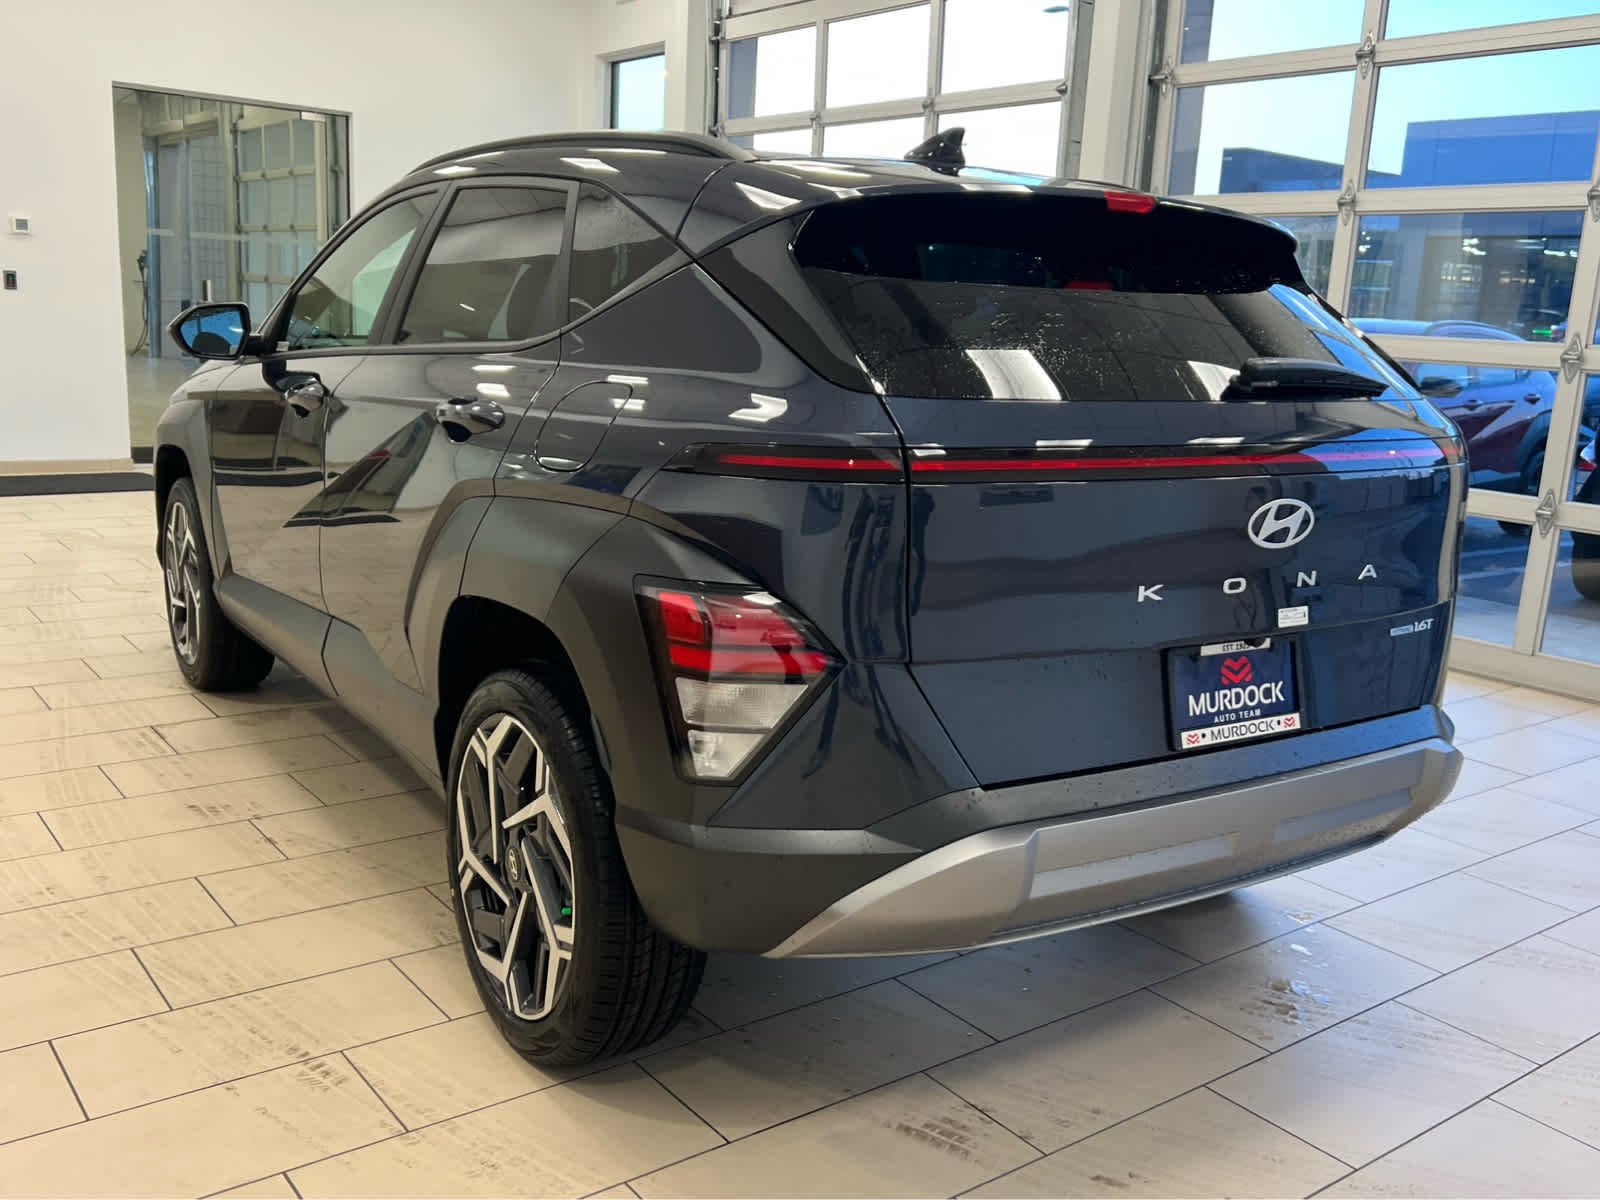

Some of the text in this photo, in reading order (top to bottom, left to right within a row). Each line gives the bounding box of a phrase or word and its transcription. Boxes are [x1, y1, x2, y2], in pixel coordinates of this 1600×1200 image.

[1137, 564, 1378, 603] KONA
[1188, 681, 1285, 716] MURDOCK
[1214, 708, 1261, 723] AUTO TEAM
[1210, 719, 1274, 741] MURDOCK
